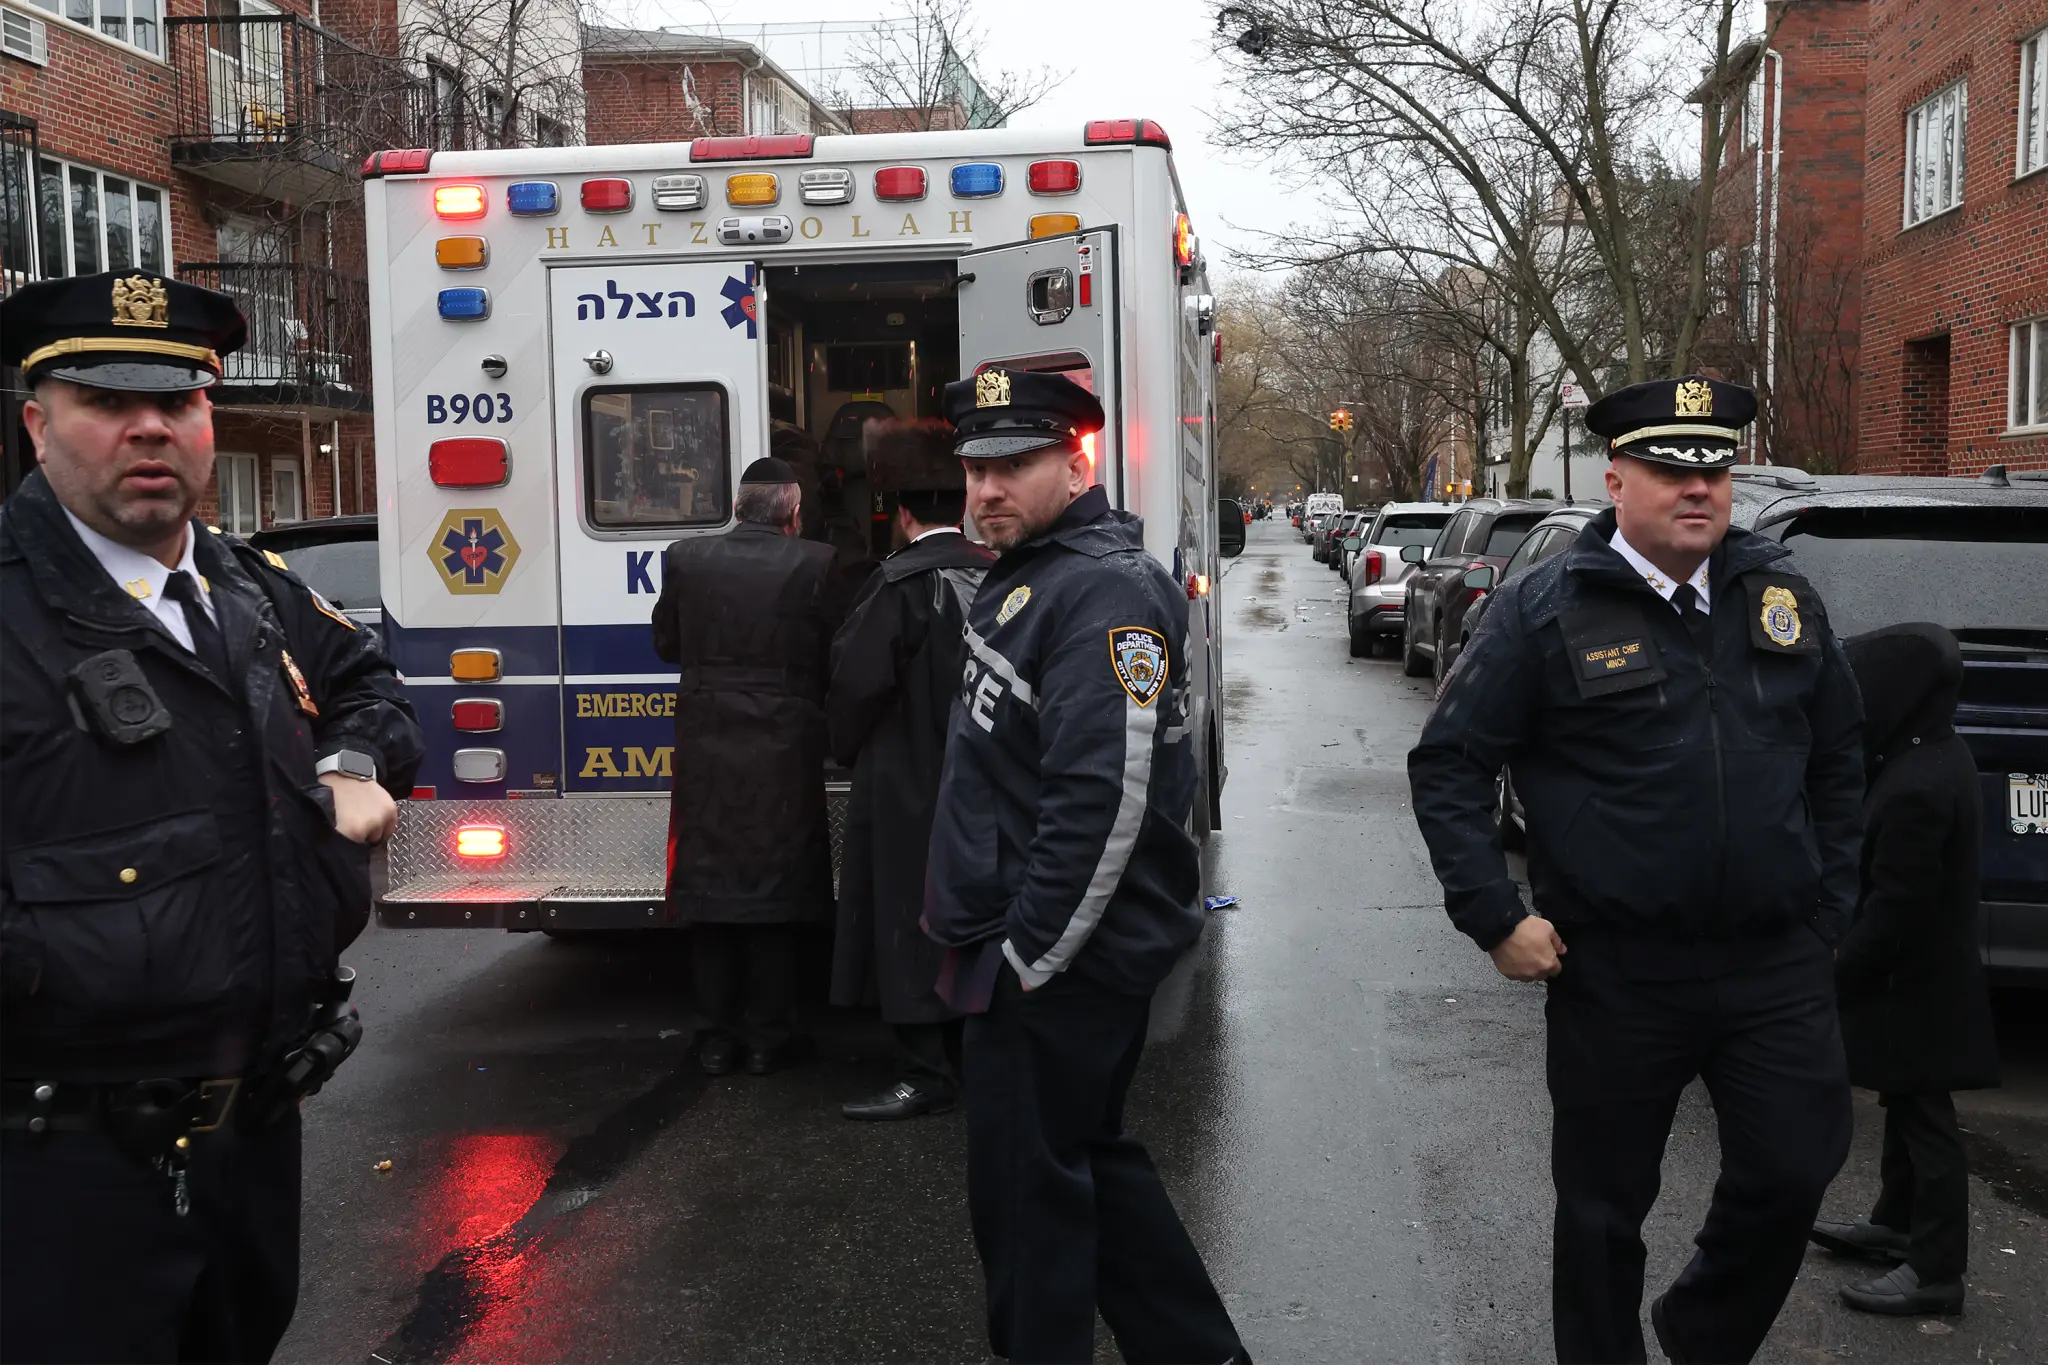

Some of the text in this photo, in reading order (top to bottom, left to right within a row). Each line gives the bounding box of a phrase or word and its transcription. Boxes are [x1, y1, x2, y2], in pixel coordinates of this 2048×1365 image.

[577, 279, 696, 321] הצלה
[427, 392, 513, 424] B903
[1116, 641, 1162, 655] DEPARTMENT
[1126, 633, 1153, 643] POLICE
[1586, 643, 1640, 662] ASSISTANT CHIEF
[1605, 658, 1626, 669] MINCH
[1116, 660, 1137, 692] CITY OF
[1146, 660, 1165, 697] NEW YORK
[576, 693, 678, 717] EMERGE
[579, 747, 675, 777] AM
